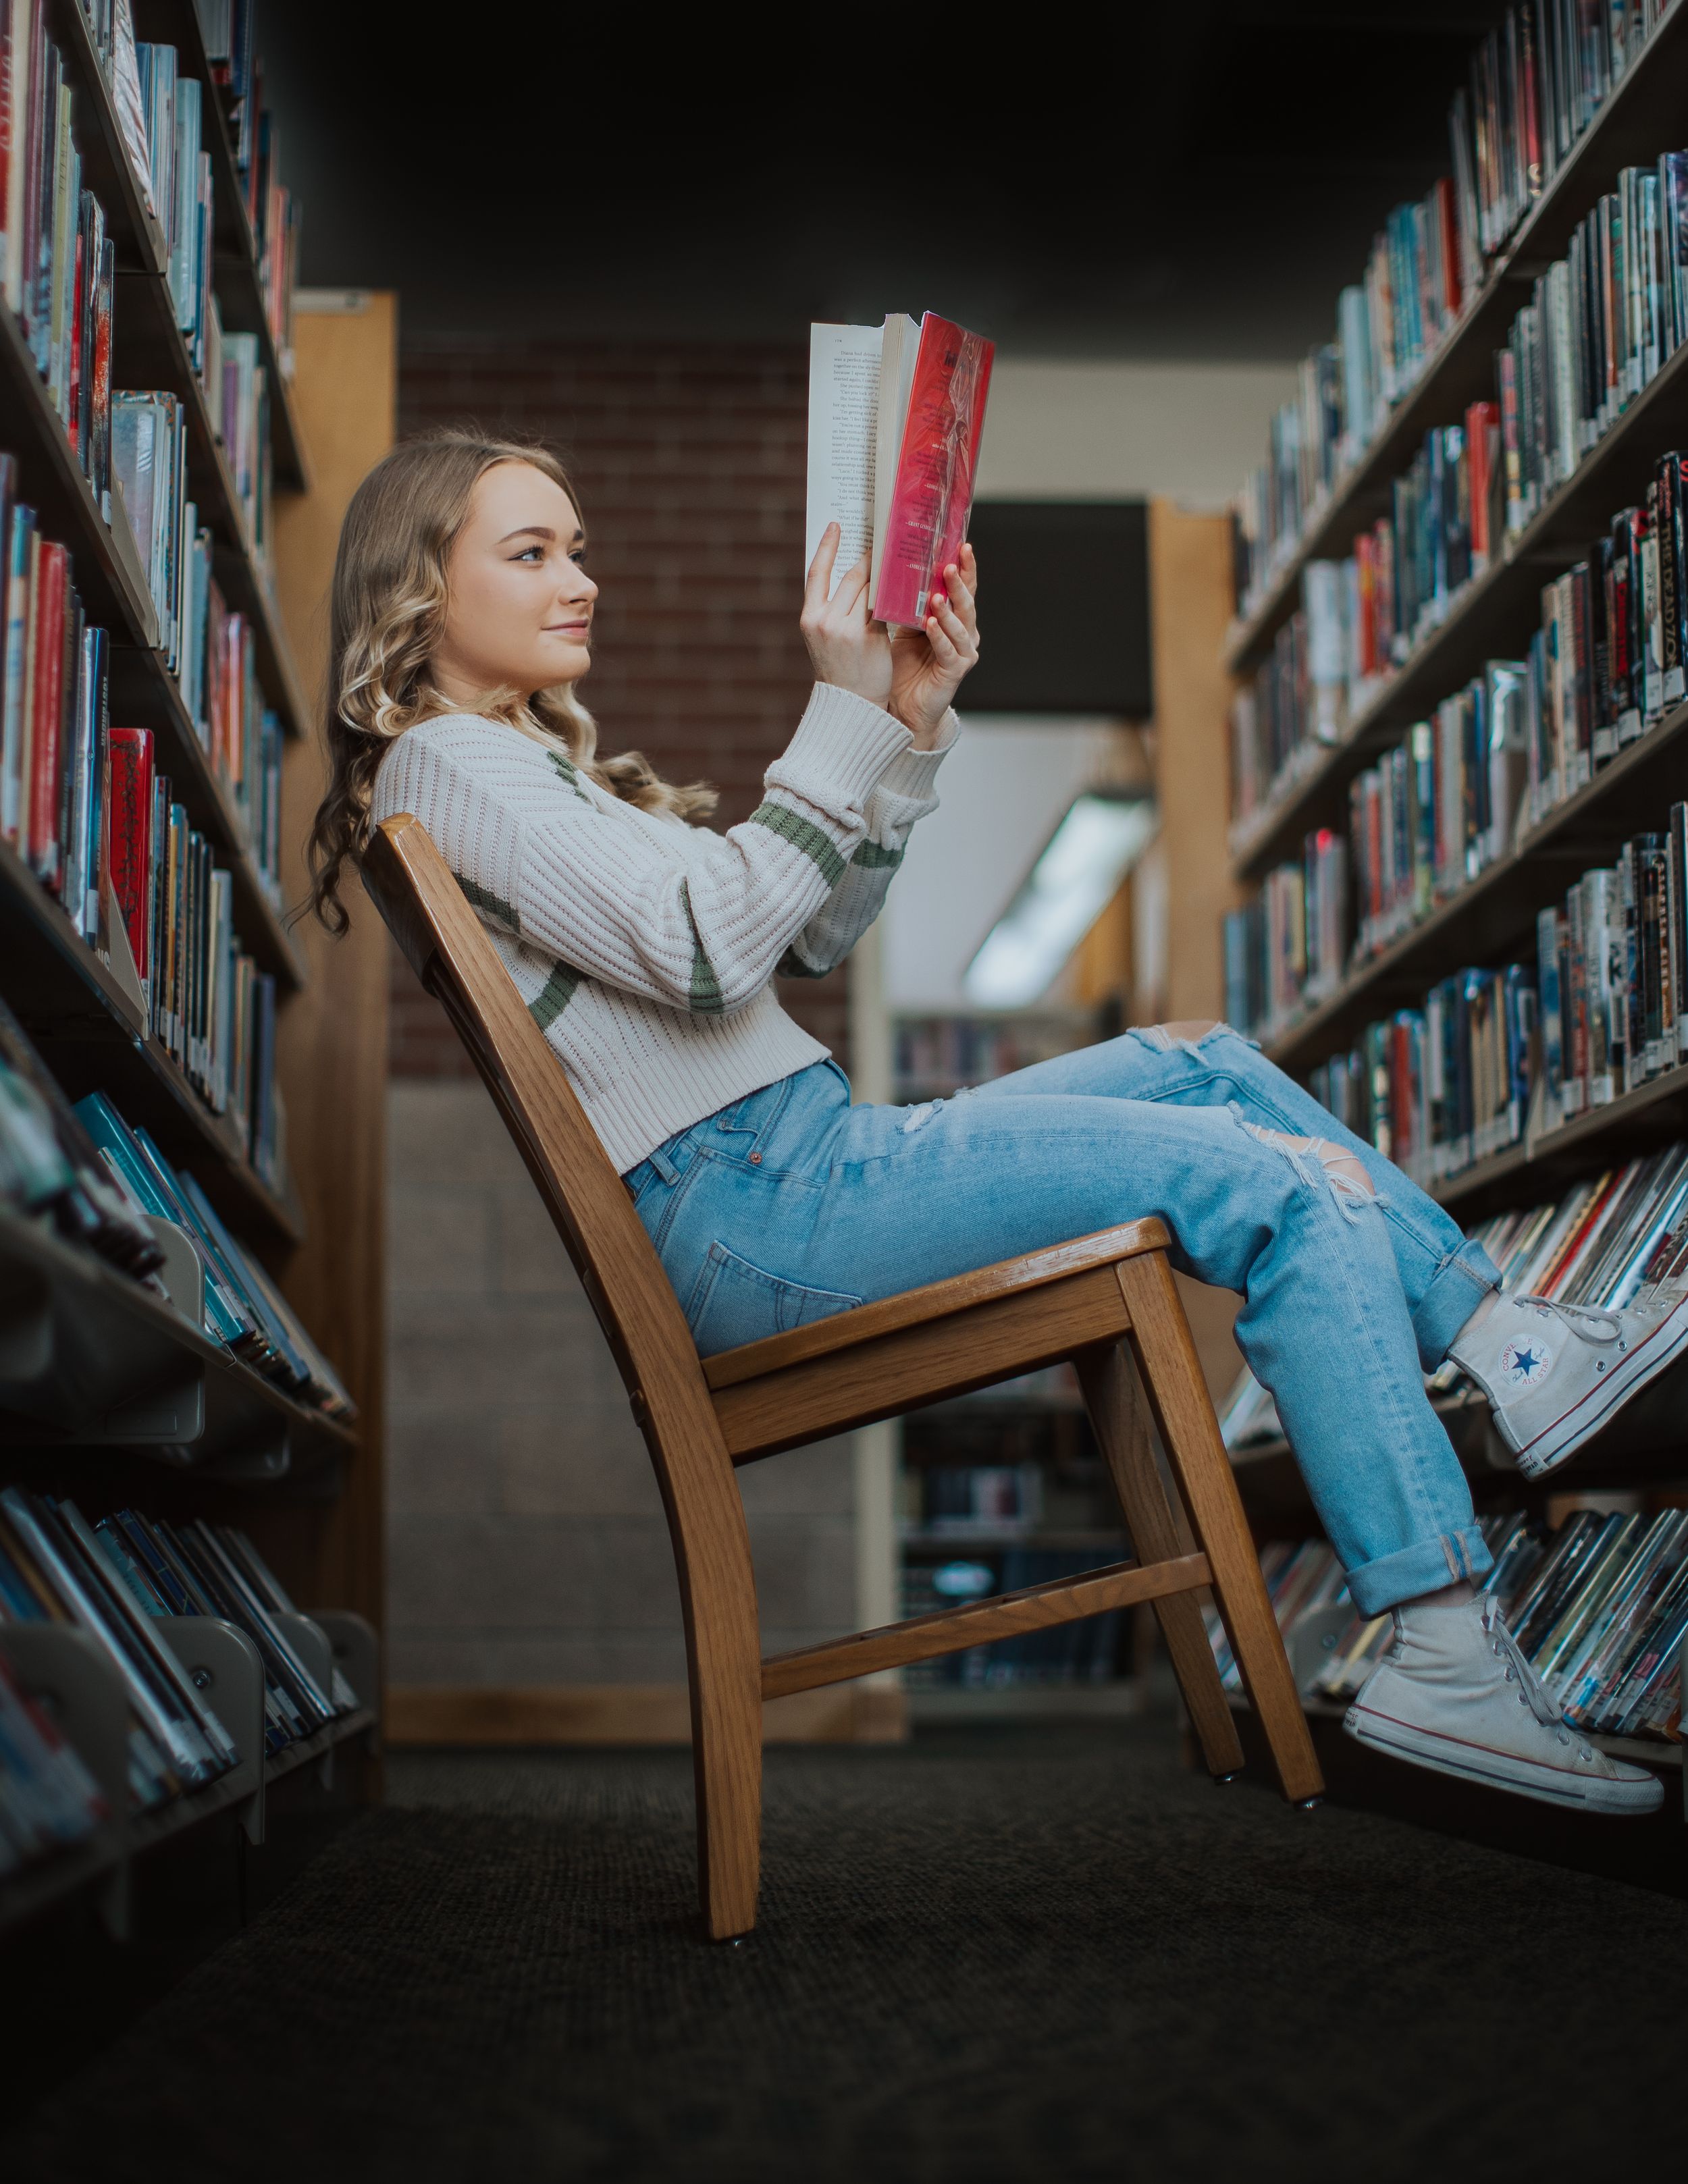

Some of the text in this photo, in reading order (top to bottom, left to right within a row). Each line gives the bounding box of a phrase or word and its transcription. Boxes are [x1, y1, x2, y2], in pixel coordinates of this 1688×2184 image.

[1502, 1338, 1533, 1372] CONVEE
[1522, 1357, 1549, 1385] ALL STAR
